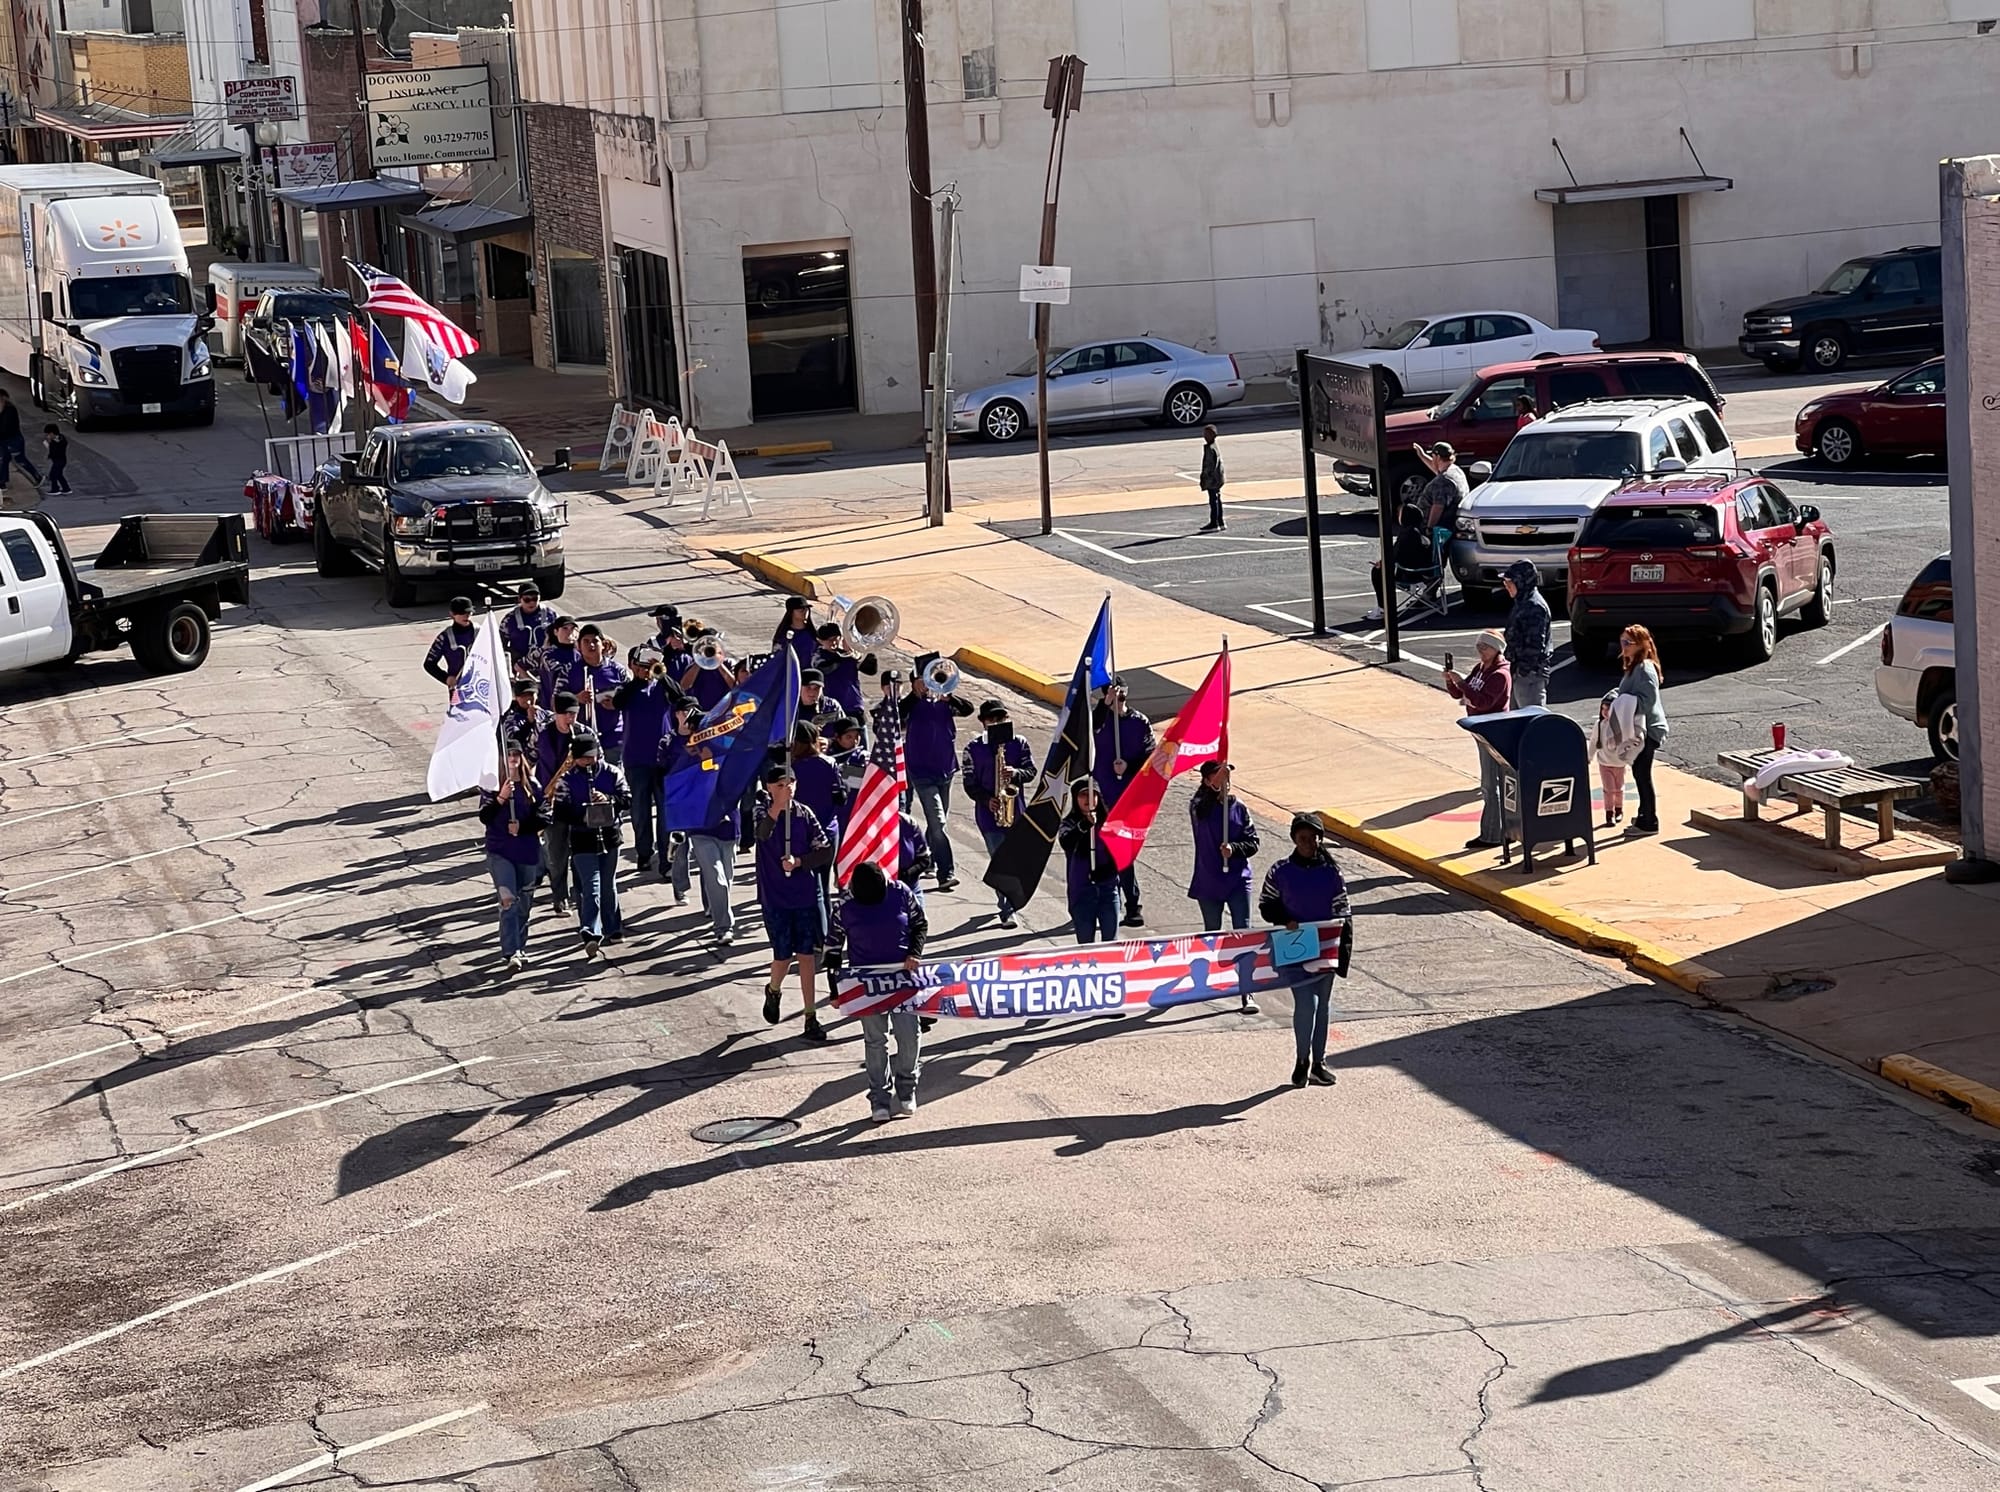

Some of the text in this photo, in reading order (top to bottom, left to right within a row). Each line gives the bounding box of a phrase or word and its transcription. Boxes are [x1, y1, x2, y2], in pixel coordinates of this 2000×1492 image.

[368, 73, 431, 86] DOGWOOD
[388, 86, 459, 99] INSURANCE
[462, 98, 486, 109] LLC
[423, 131, 489, 144] 903-729-7705
[376, 155, 401, 164] Auto,
[434, 147, 490, 158] Commercial
[23, 211, 33, 269] 134073
[862, 960, 999, 994] THANK YOU
[971, 974, 1122, 1016] VETERANS
